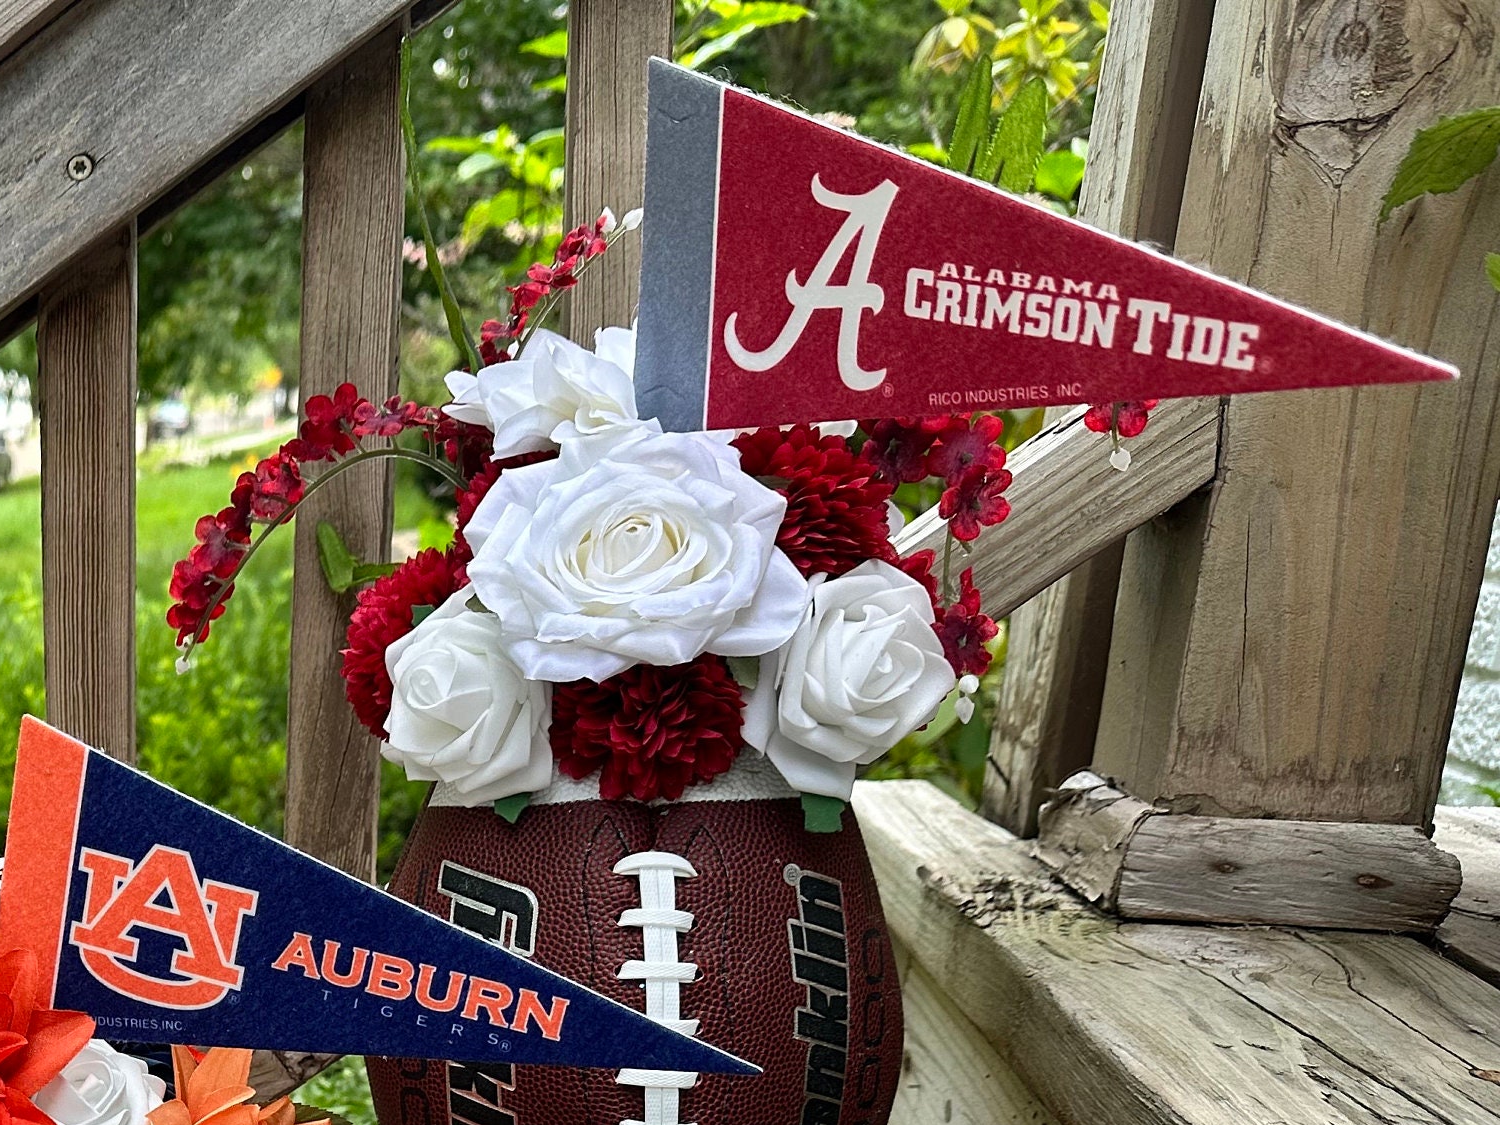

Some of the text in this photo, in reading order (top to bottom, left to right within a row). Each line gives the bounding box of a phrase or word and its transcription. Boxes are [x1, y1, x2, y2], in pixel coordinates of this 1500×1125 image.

[723, 172, 900, 391] A
[904, 267, 1260, 371] CRIMSON TIDE
[938, 262, 1120, 301] ALABAMA
[928, 393, 961, 406] RICO
[271, 932, 571, 1042] AUBURN
[321, 989, 499, 1046] TIGERS
